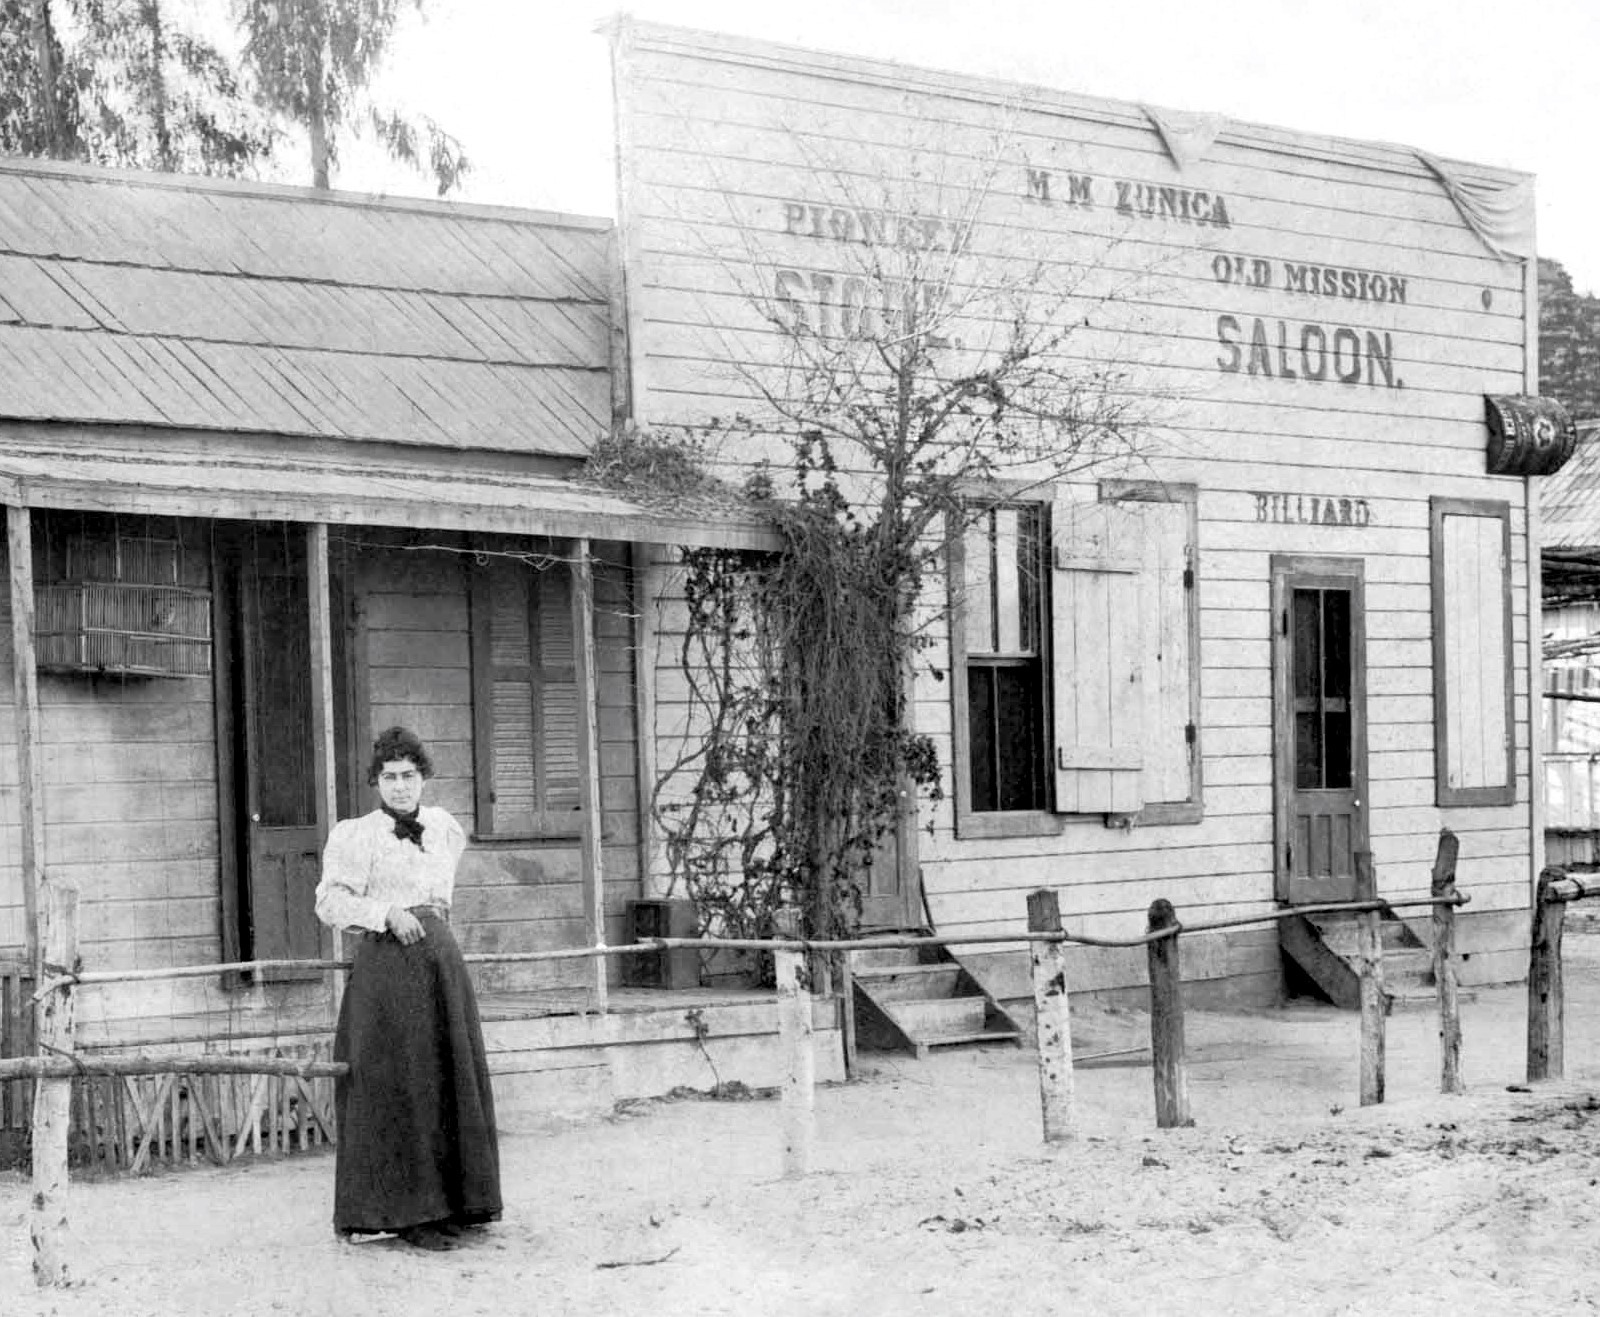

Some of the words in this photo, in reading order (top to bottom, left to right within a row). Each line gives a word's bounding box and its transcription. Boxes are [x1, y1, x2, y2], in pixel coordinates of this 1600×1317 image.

[1027, 168, 1051, 206] M
[1068, 174, 1092, 211] M
[1115, 181, 1231, 229] ZUNICA
[1211, 255, 1272, 289] OLD
[1284, 263, 1408, 304] MISSION
[1217, 315, 1404, 389] SALOON.
[1255, 492, 1371, 528] BILLIARD
